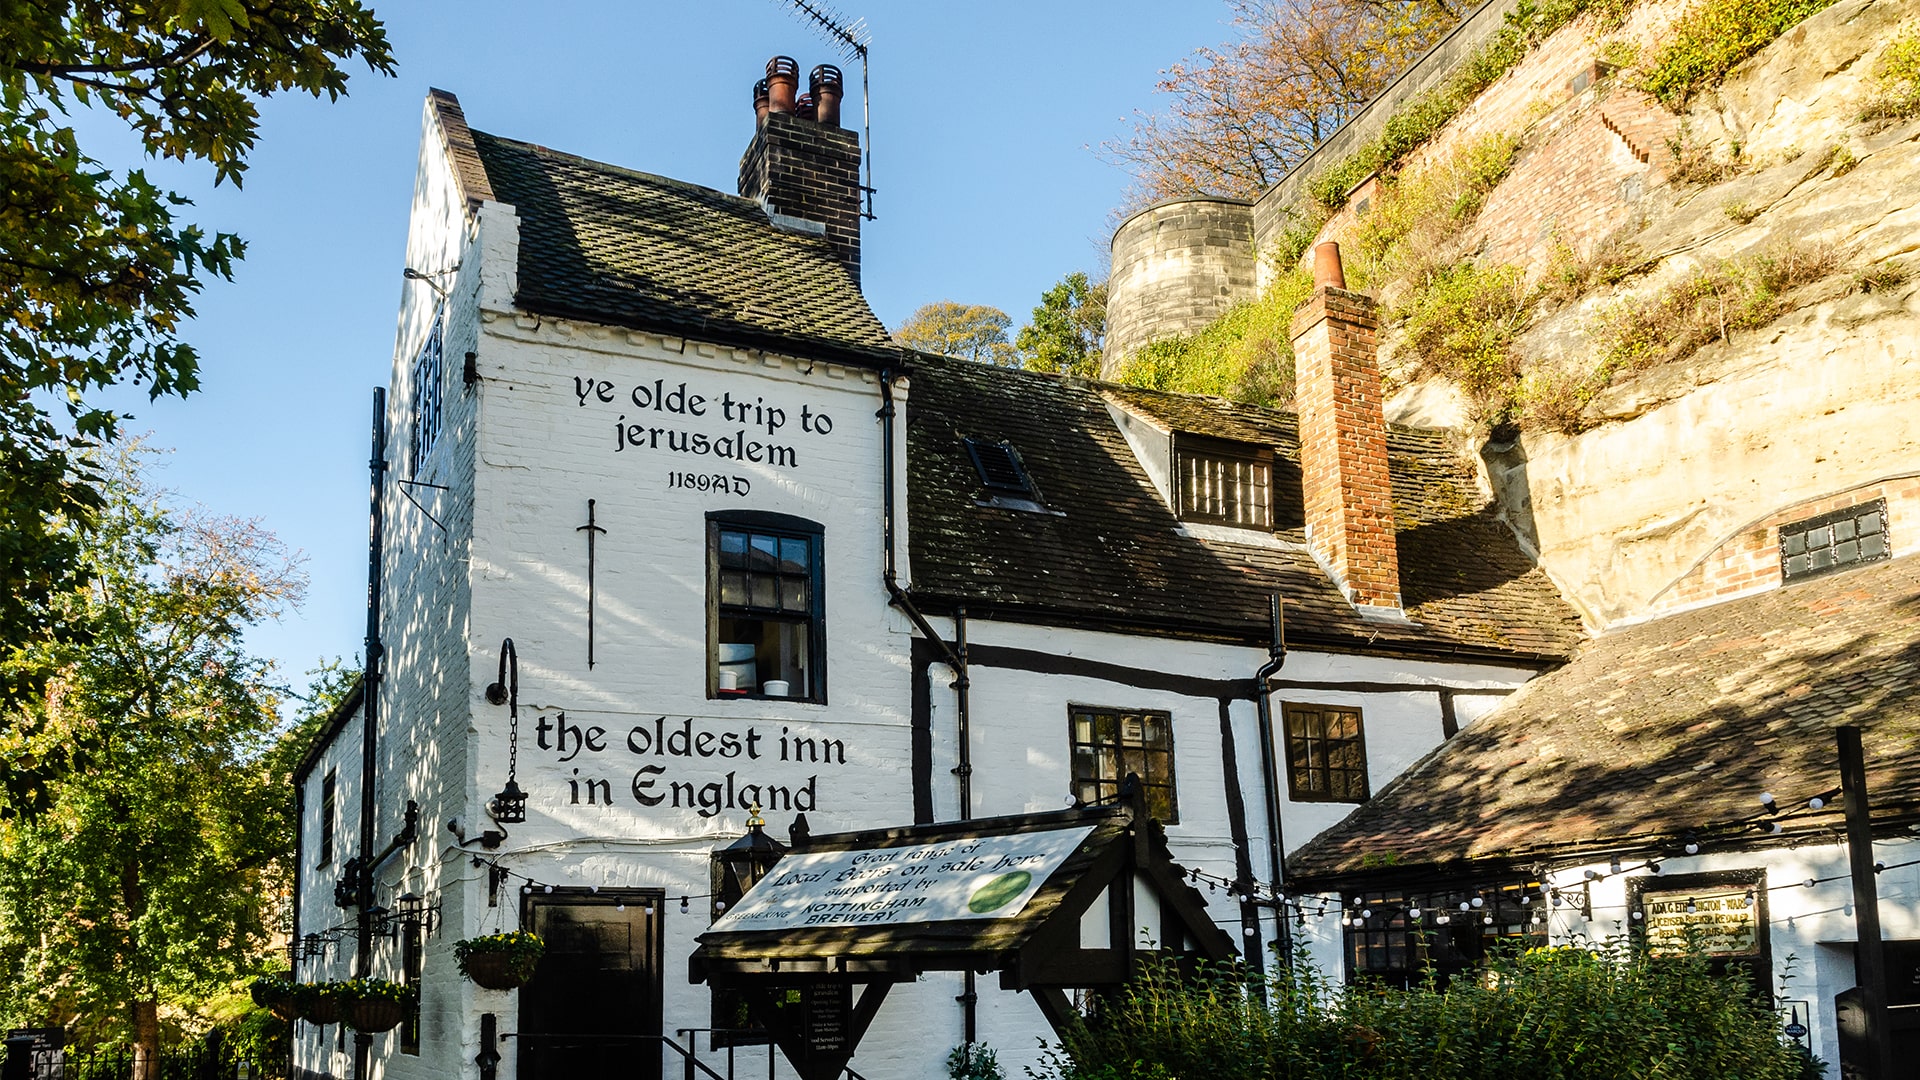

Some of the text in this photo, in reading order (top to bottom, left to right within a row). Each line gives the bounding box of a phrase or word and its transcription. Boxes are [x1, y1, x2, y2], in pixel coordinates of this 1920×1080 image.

[574, 376, 833, 436] ye olde trip to
[614, 415, 799, 468] jerusalem
[668, 471, 751, 497] 1189AD
[536, 712, 847, 764] the oldest inn
[569, 765, 817, 818] in England
[852, 841, 987, 866] Great range of
[772, 853, 1046, 887] Local Beers on sale here
[825, 877, 938, 897] supported by
[725, 910, 790, 920] GREENE KING
[800, 897, 927, 915] NOTTINGHAM
[804, 909, 899, 925] BREWERY
